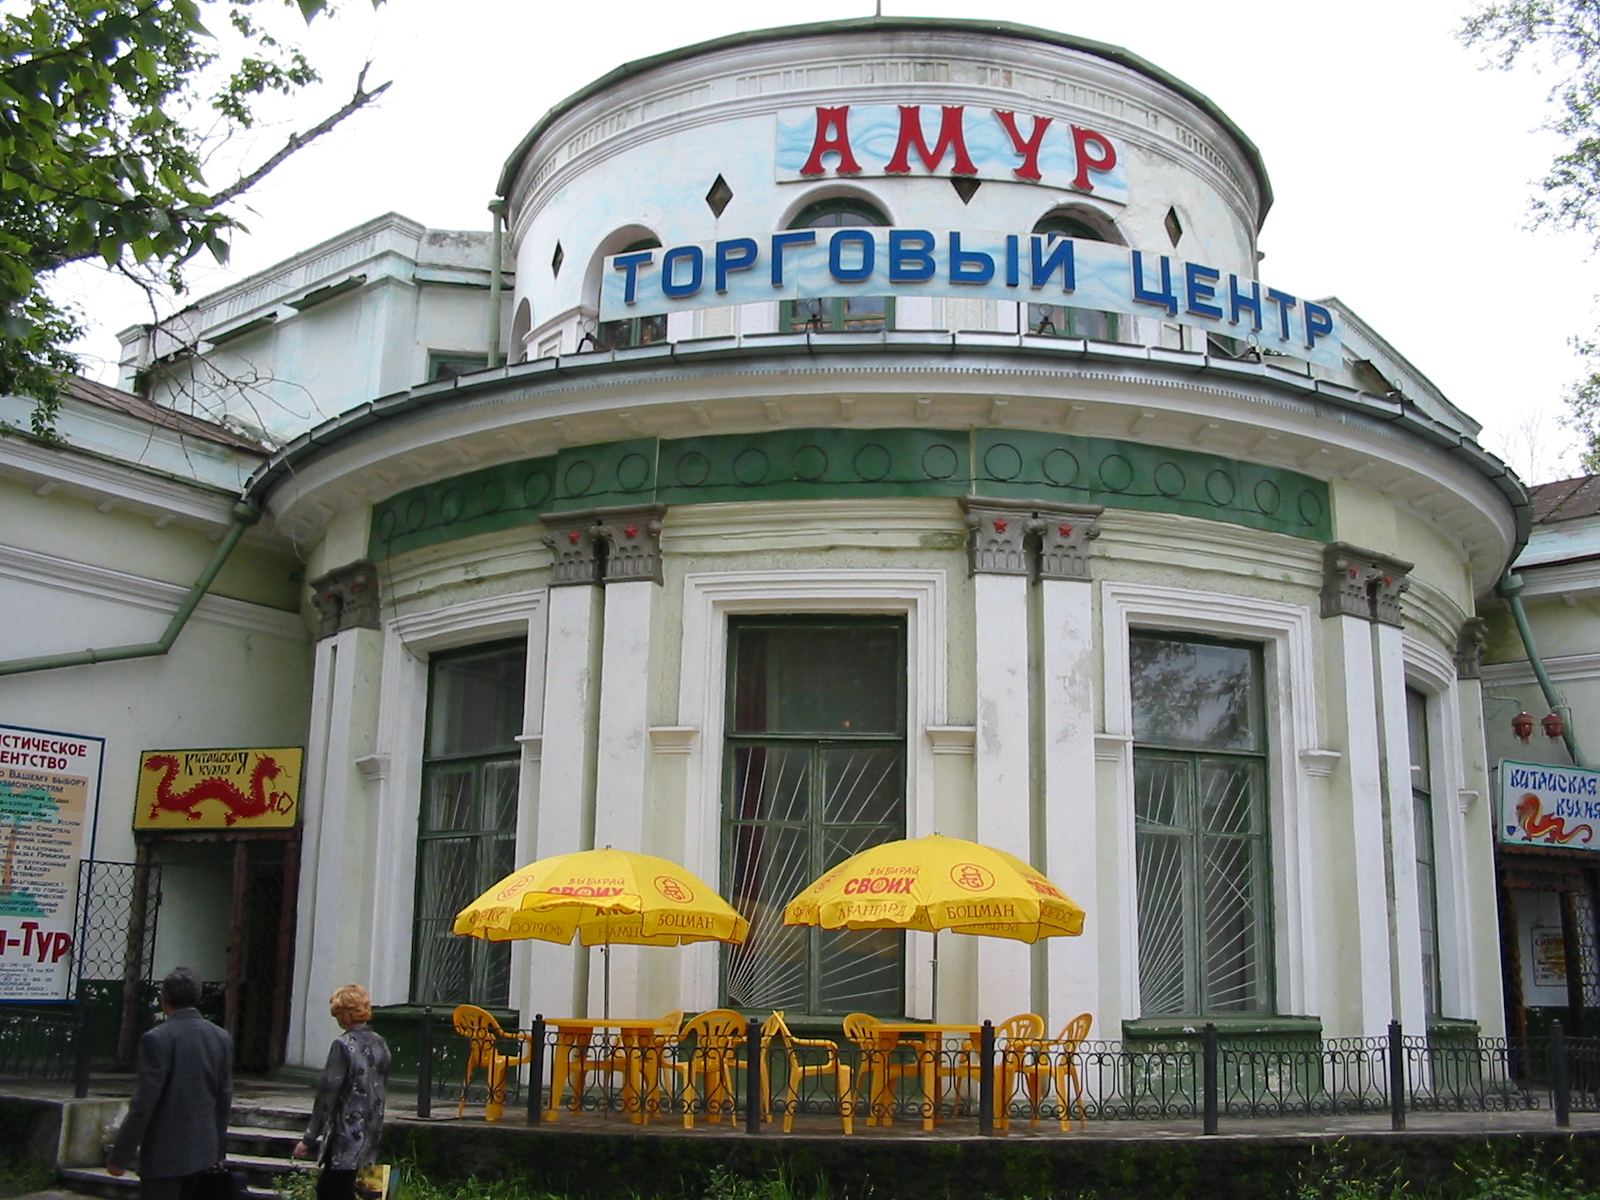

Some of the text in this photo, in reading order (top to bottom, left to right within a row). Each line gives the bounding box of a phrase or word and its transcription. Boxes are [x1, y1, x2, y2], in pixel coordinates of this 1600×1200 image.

[800, 104, 1117, 192] АМУР
[612, 228, 1335, 350] ТОРГОВЫЙ ЦЕНТР
[1556, 798, 1600, 820] КУХНЯ
[843, 876, 915, 896] СВОИХ
[657, 913, 716, 931] БОЦМАН
[946, 903, 1015, 922] БОЦМАН
